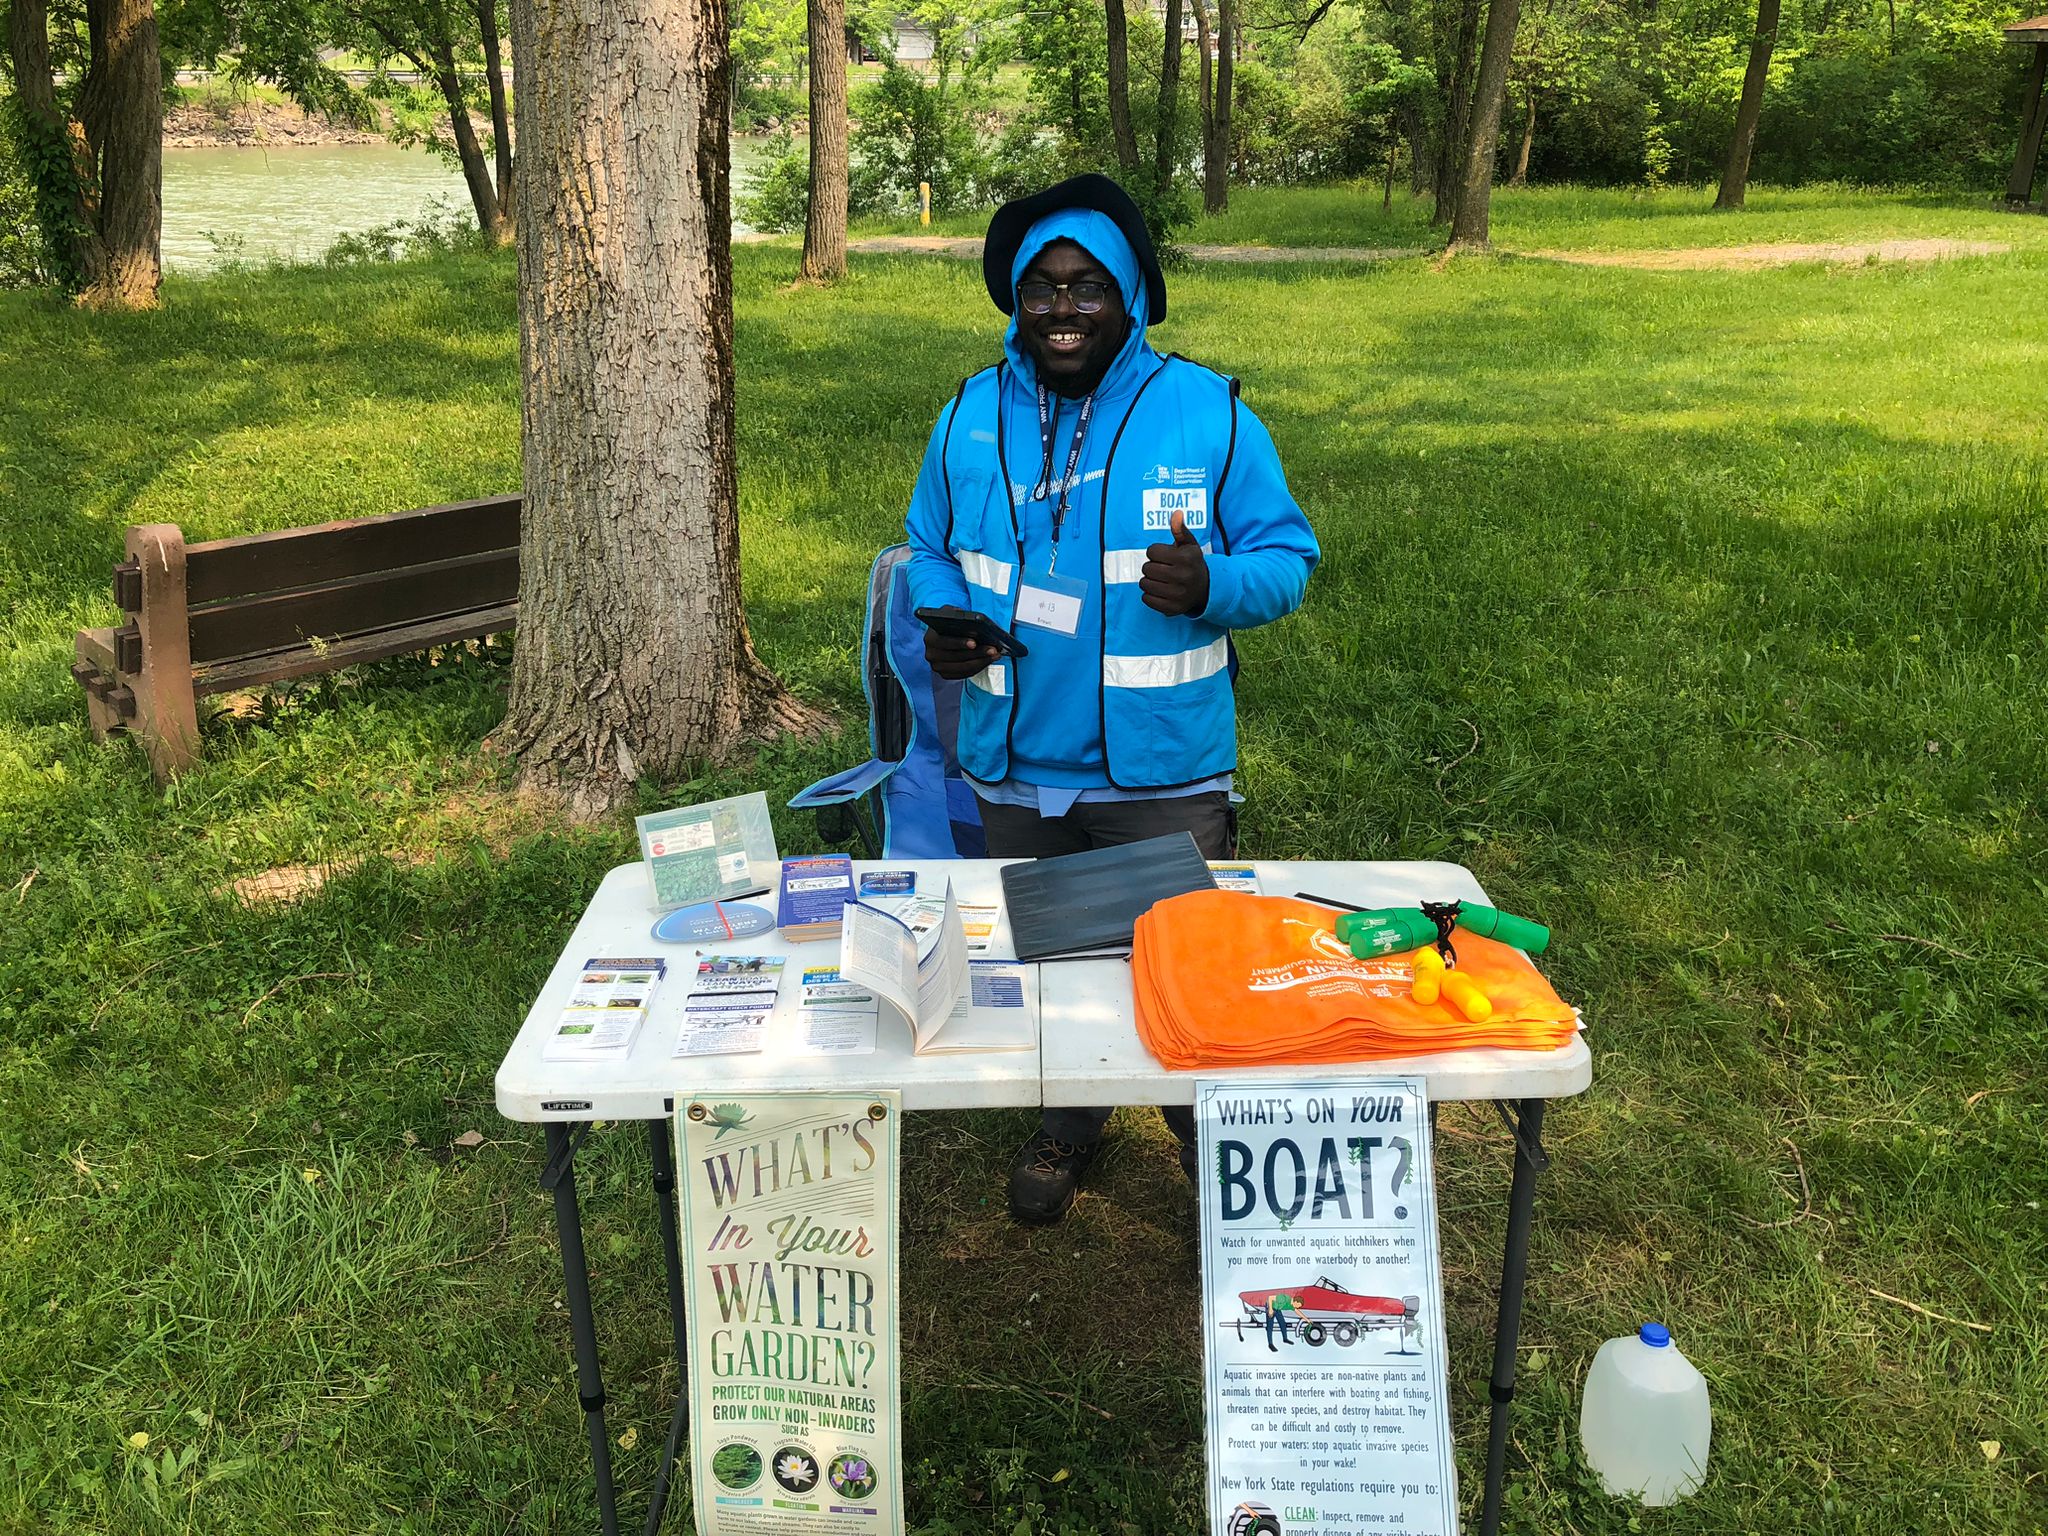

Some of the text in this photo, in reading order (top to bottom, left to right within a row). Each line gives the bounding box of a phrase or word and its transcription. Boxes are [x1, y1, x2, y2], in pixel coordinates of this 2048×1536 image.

[1160, 492, 1191, 508] BOAT
[1146, 510, 1204, 526] STERD
[1251, 959, 1314, 976] EQUIPMENT
[1300, 965, 1368, 975] DRAIN.
[1249, 972, 1295, 986] DRY.
[1216, 1096, 1403, 1126] WHAT'S ON YOUR
[702, 1118, 876, 1209] WHAT'S
[1216, 1136, 1413, 1221] BOAT?
[708, 1214, 874, 1261] In Your
[1220, 1235, 1415, 1250] Watch for unwanted aquatic hitchhikers when
[1227, 1253, 1410, 1268] you move from one waterbody to another!
[707, 1262, 876, 1337] WATER
[710, 1330, 876, 1389] GARDEN?
[1223, 1368, 1426, 1384] Aquatic invasive species are non-native plants and
[712, 1385, 876, 1414] PROTECT OUR NATURAL AREAS
[1221, 1385, 1432, 1402] animals that can interfere with boating and fishing,
[713, 1405, 748, 1420] GROW
[752, 1405, 781, 1422] ONLY
[1227, 1402, 1426, 1420] threaten native species, and destroy habitat. They
[781, 1424, 809, 1437] SUCH AS
[1251, 1420, 1404, 1436] can be difficult and costly to remove.
[774, 1438, 794, 1447] Fragrant
[1228, 1437, 1429, 1455] Protect your waters: stop aquatic invasive species
[1300, 1456, 1356, 1471] in your wake!
[1222, 1476, 1439, 1498] New York State regulations require you to:
[1284, 1506, 1404, 1525] CLEAN: Inspect, remove and
